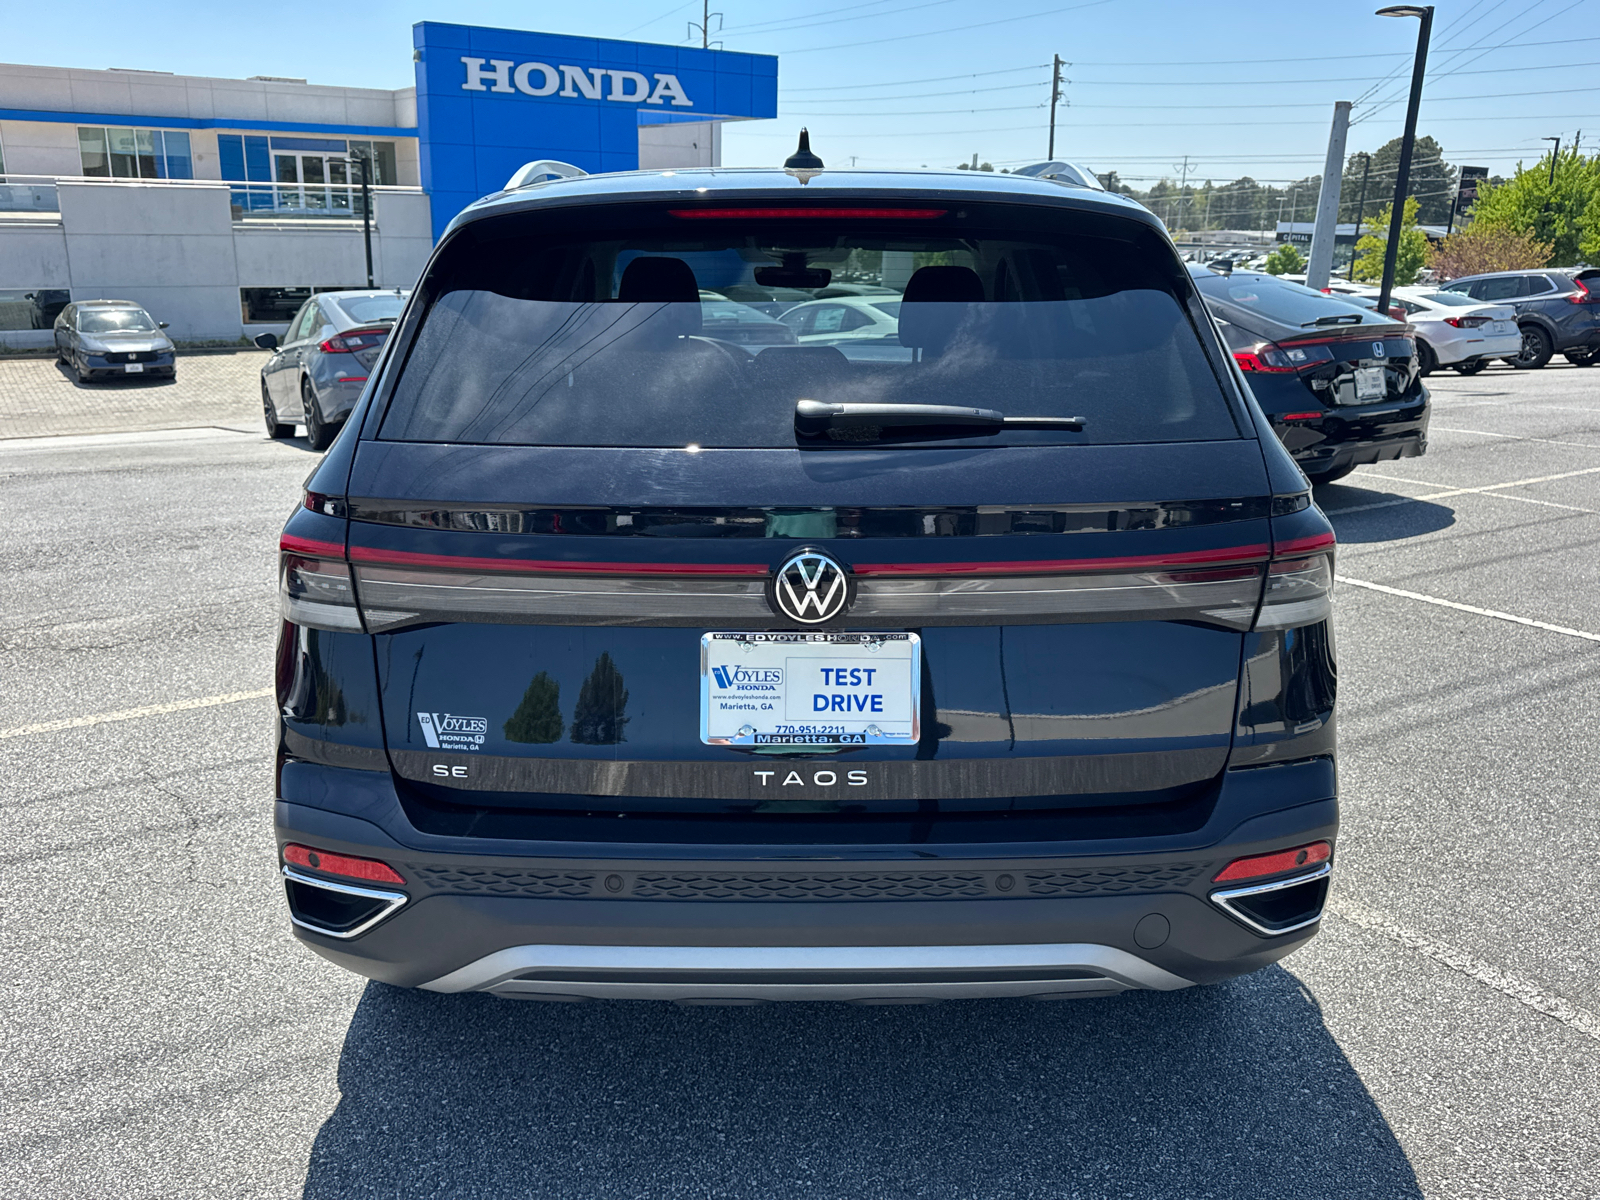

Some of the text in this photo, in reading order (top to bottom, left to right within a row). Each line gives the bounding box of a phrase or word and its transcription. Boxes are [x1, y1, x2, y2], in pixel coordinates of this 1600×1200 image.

[460, 56, 694, 107] HONDA
[720, 665, 781, 687] VOYLES
[820, 667, 877, 686] TEST
[719, 702, 774, 711] Marietta, GA
[813, 694, 883, 712] DRIVE
[432, 713, 486, 734] VOYLES
[775, 725, 845, 733] 770-951-2211
[756, 734, 864, 743] Marietta, GA
[442, 743, 469, 751] Marietta,
[432, 764, 468, 778] SE
[753, 770, 868, 786] TAOS
